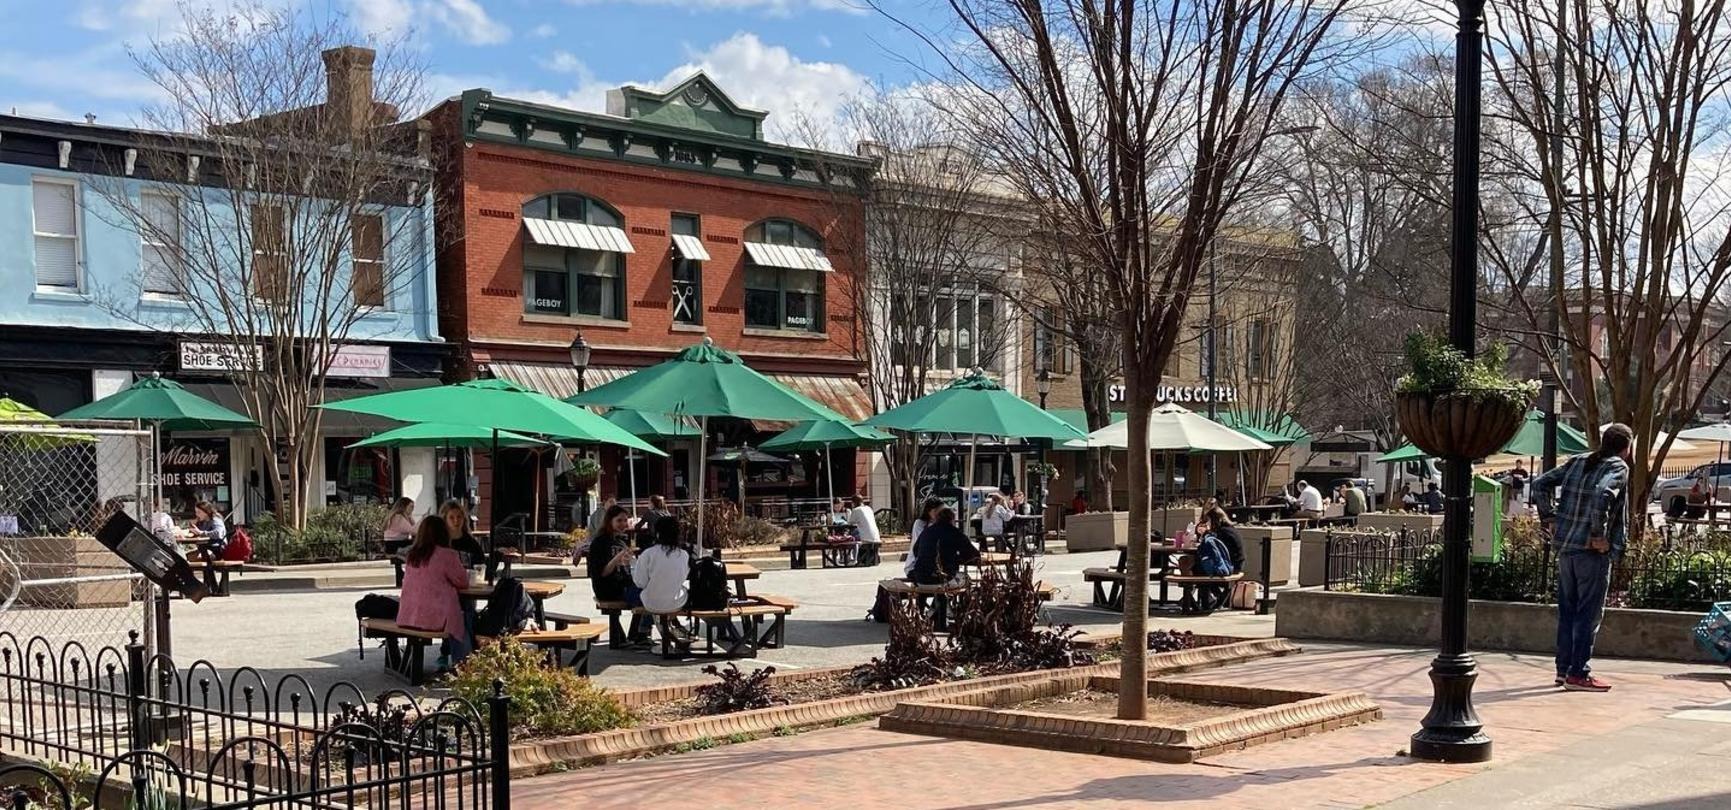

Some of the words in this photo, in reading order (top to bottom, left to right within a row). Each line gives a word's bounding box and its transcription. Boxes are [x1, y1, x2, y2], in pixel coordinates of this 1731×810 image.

[183, 354, 212, 366] SHOE
[1109, 385, 1192, 402] STUCKS
[160, 445, 219, 465] Marvin
[185, 472, 225, 485] SERVICE
